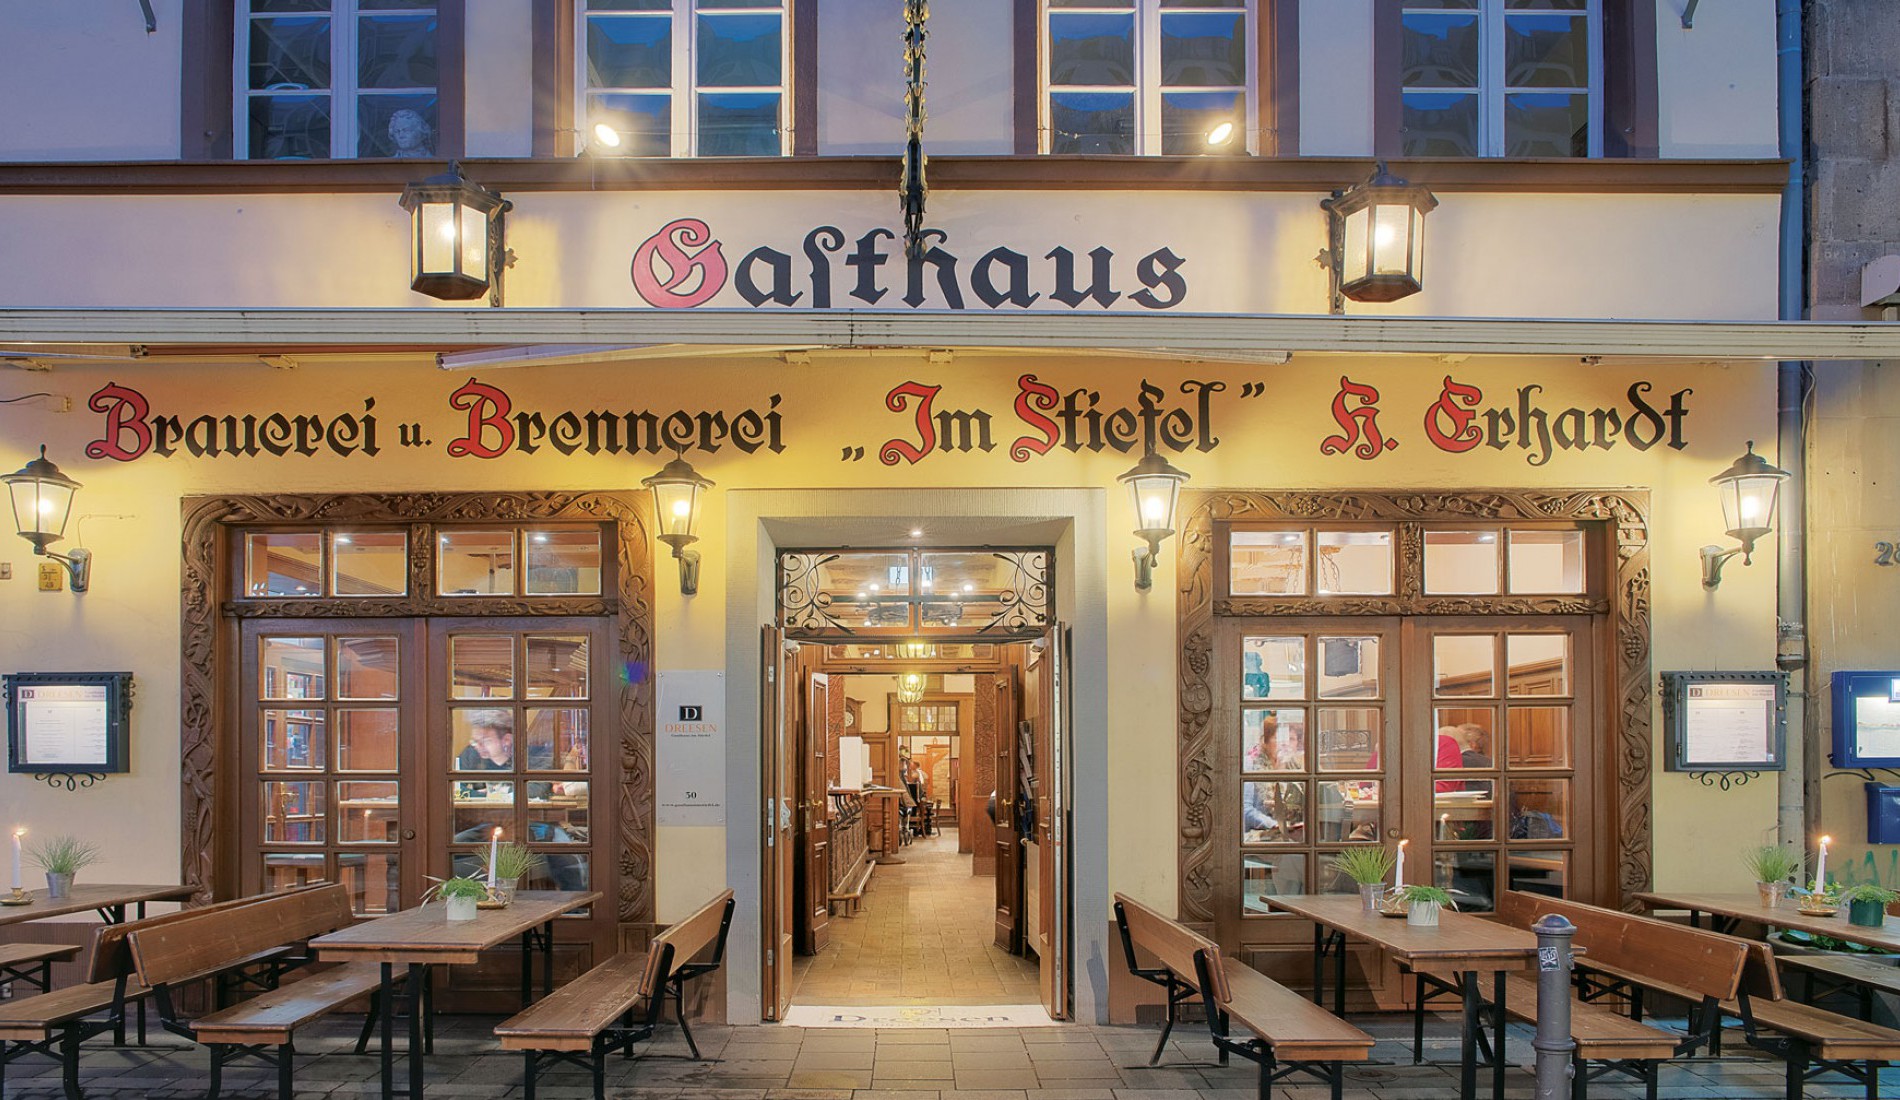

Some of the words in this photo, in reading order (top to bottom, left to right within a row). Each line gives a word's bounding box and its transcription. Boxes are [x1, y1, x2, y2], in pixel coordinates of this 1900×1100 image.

[85, 381, 381, 462] Brauerei
[398, 422, 432, 447] u.
[447, 377, 787, 460] Brennerei
[1424, 375, 1694, 467] Erhardt
